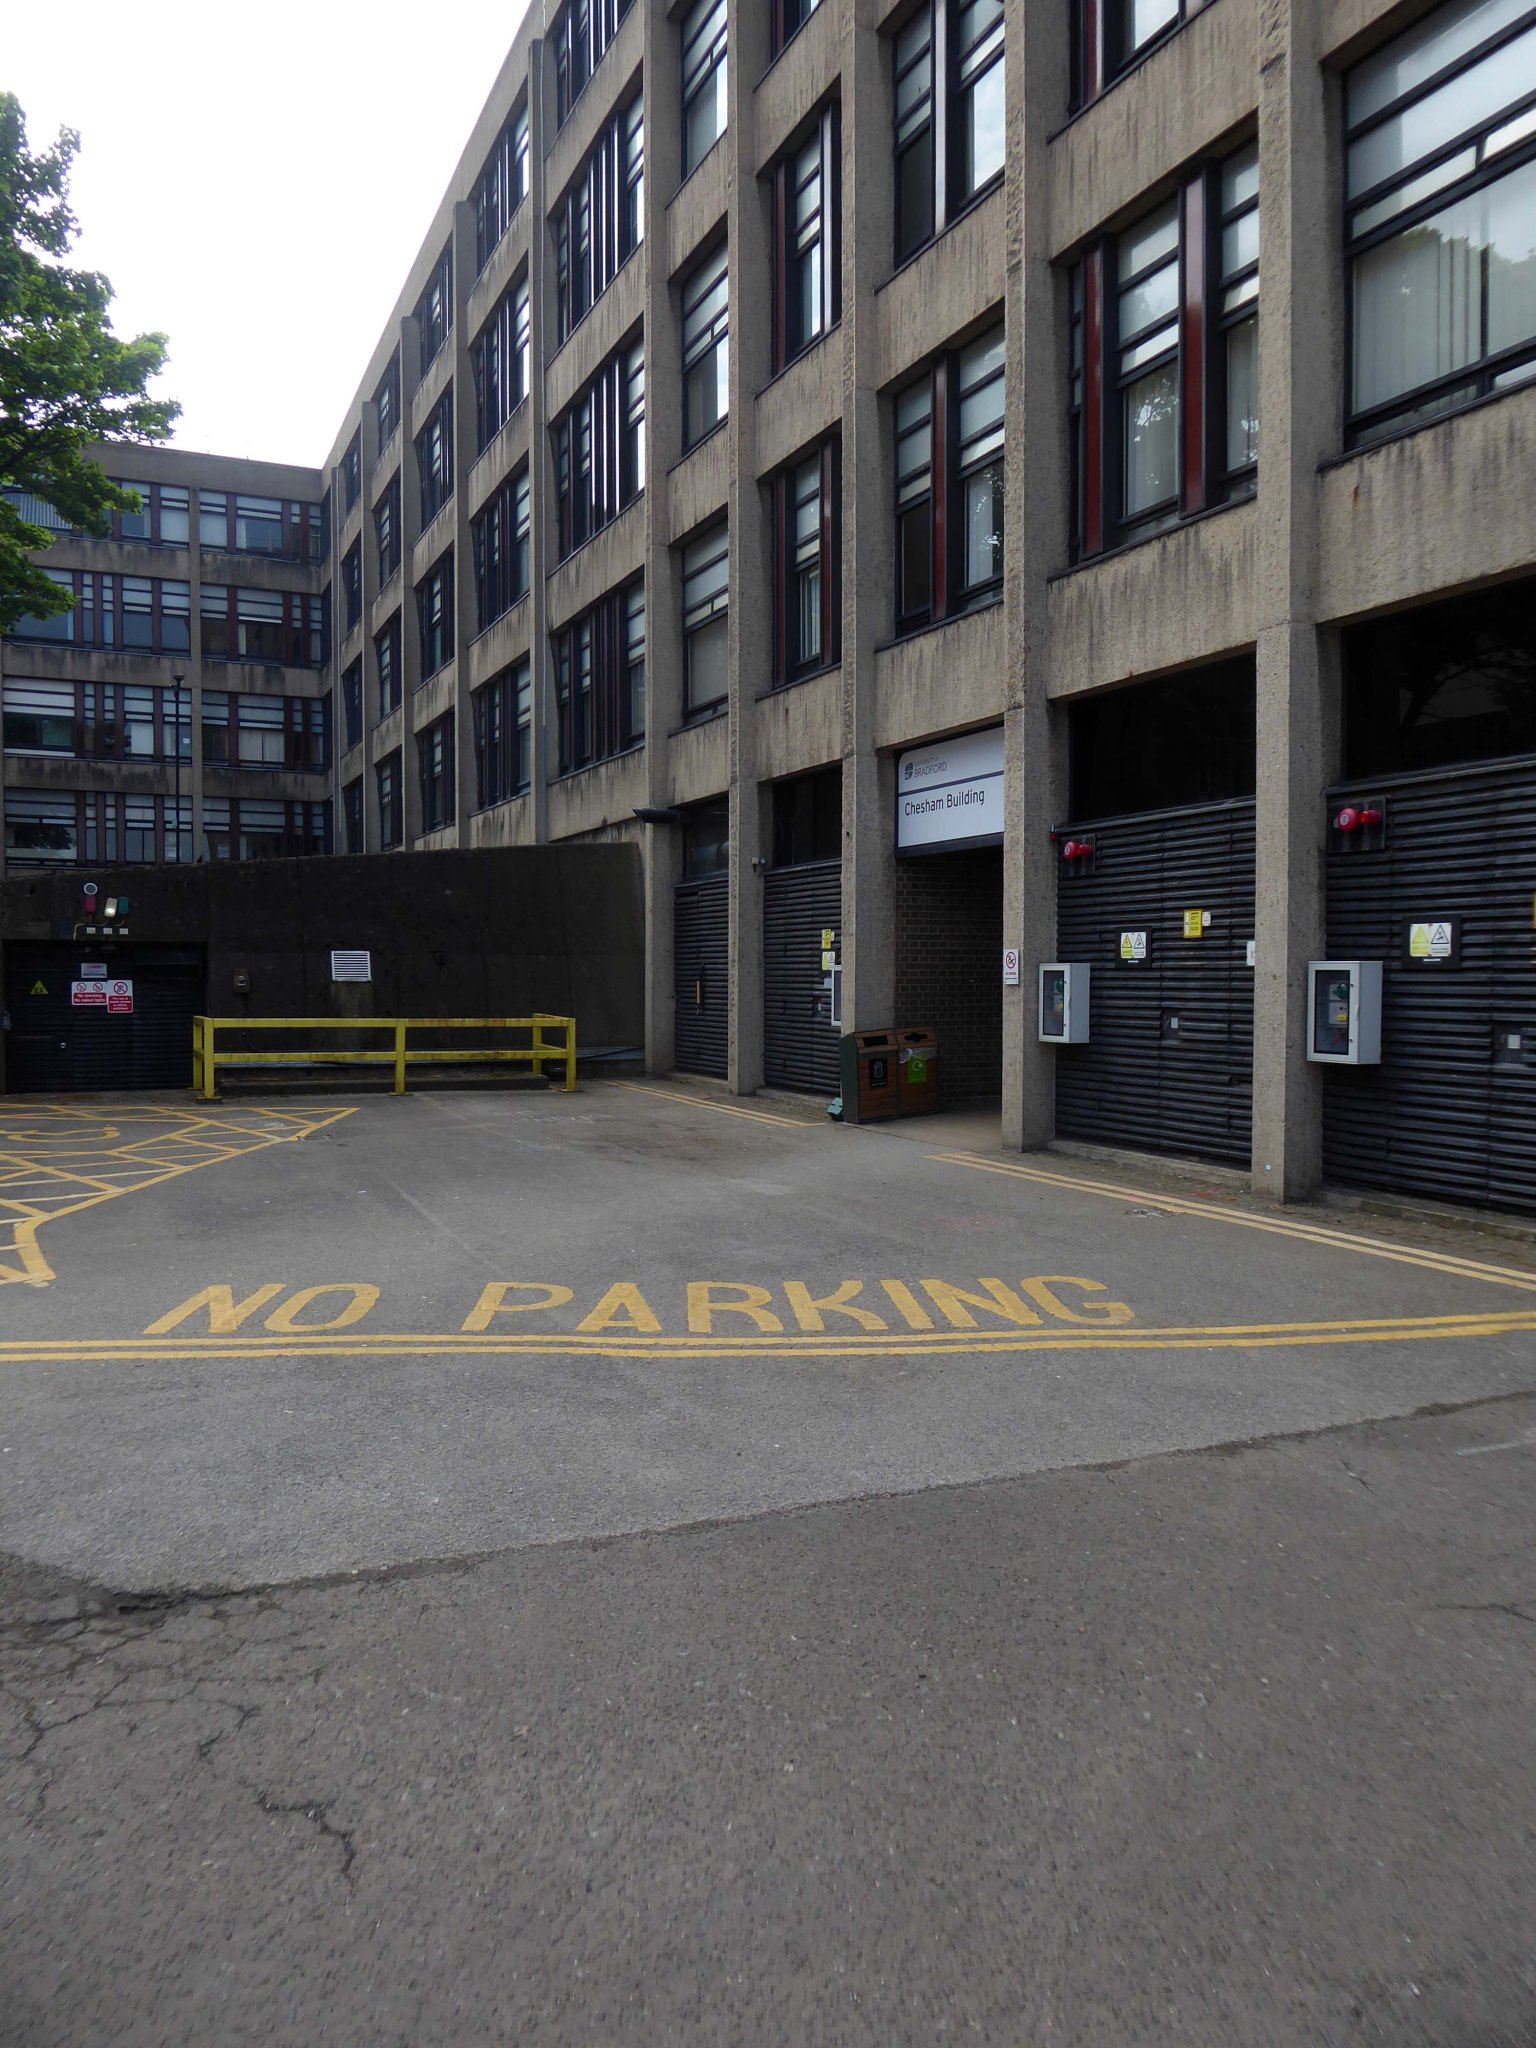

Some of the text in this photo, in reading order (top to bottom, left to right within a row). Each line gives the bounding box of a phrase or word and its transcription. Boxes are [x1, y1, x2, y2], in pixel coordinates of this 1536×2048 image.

[914, 761, 948, 778] BRADFORD
[904, 789, 985, 816] Chesham Building
[142, 1274, 1135, 1335] NO PARKING
